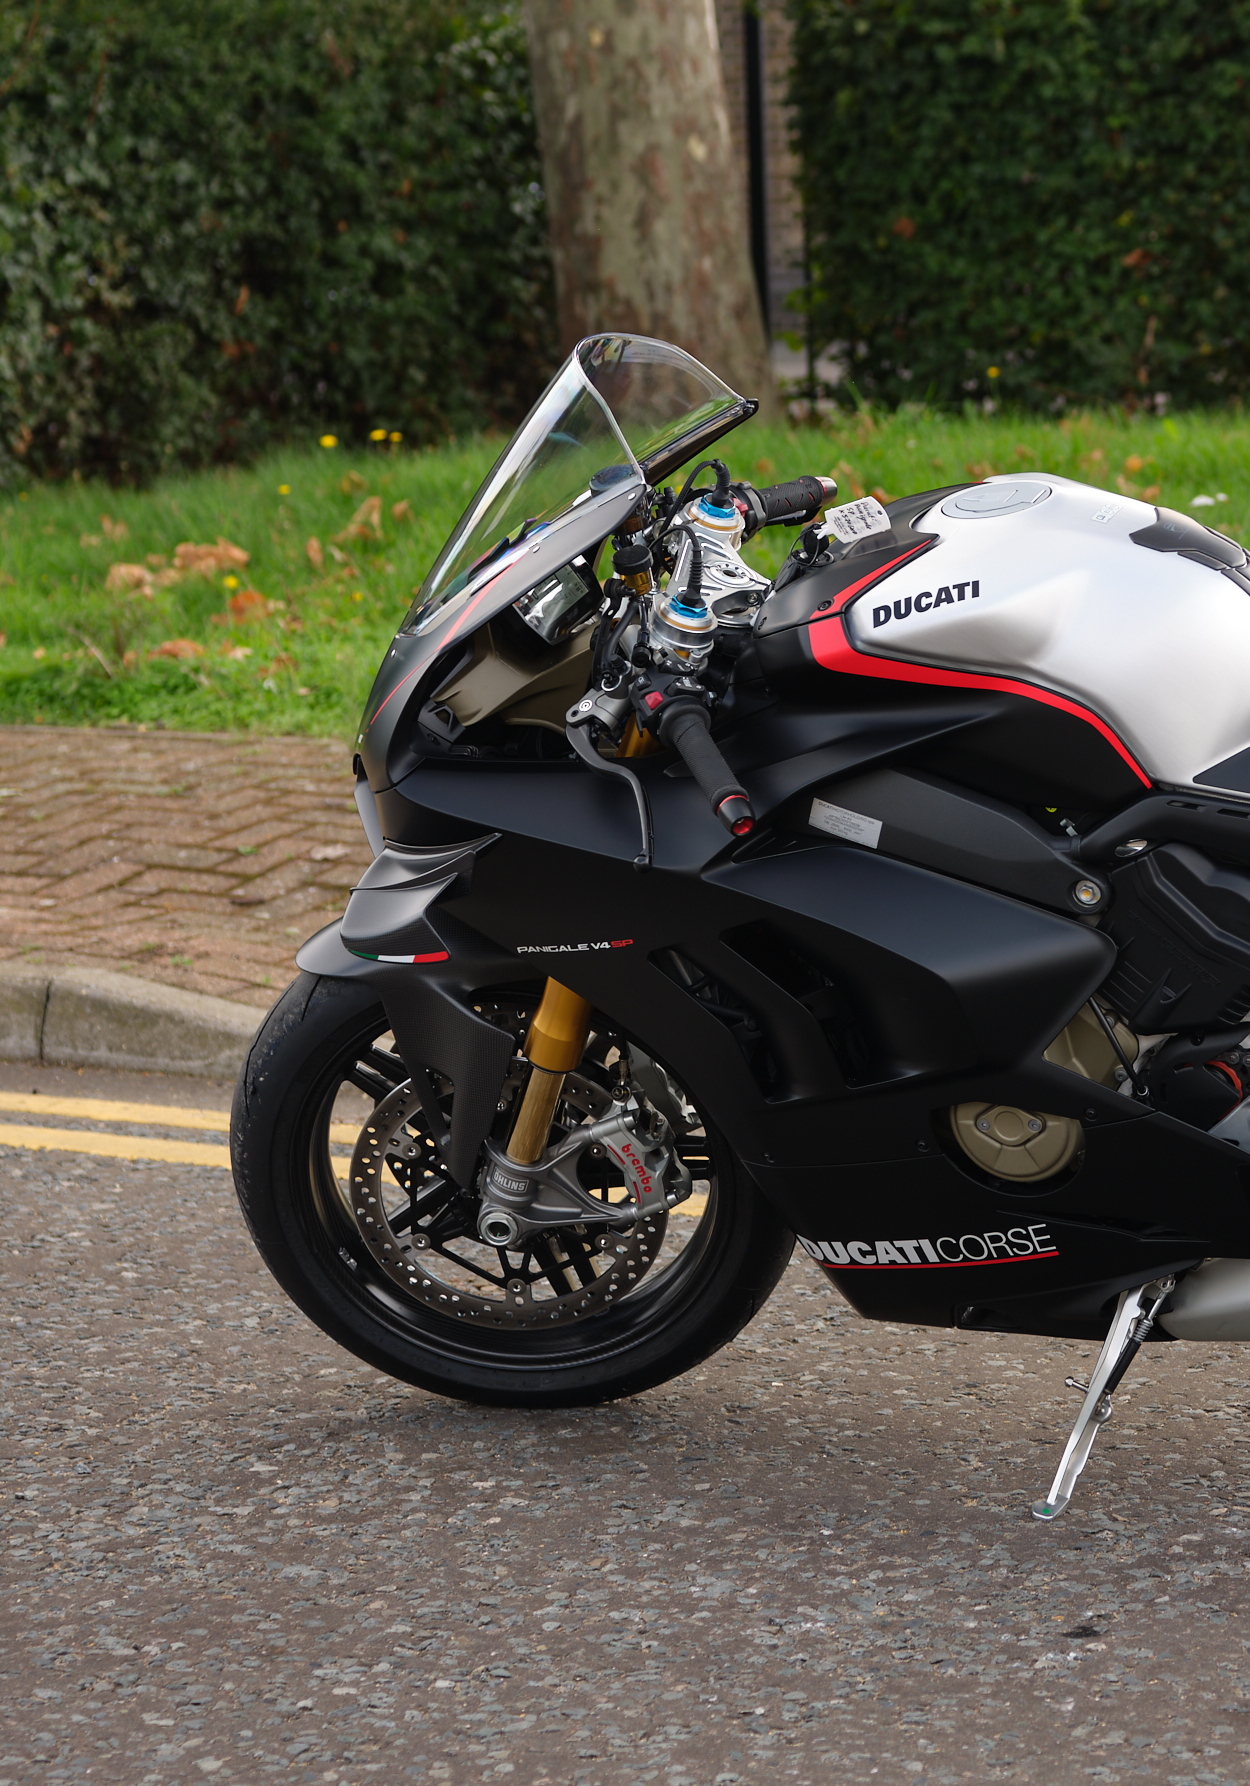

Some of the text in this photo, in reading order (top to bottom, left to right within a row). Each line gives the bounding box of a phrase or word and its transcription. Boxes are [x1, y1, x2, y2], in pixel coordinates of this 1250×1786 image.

[873, 580, 980, 629] DUCATI
[517, 943, 589, 953] PANIGALE
[621, 1143, 652, 1193] brembo
